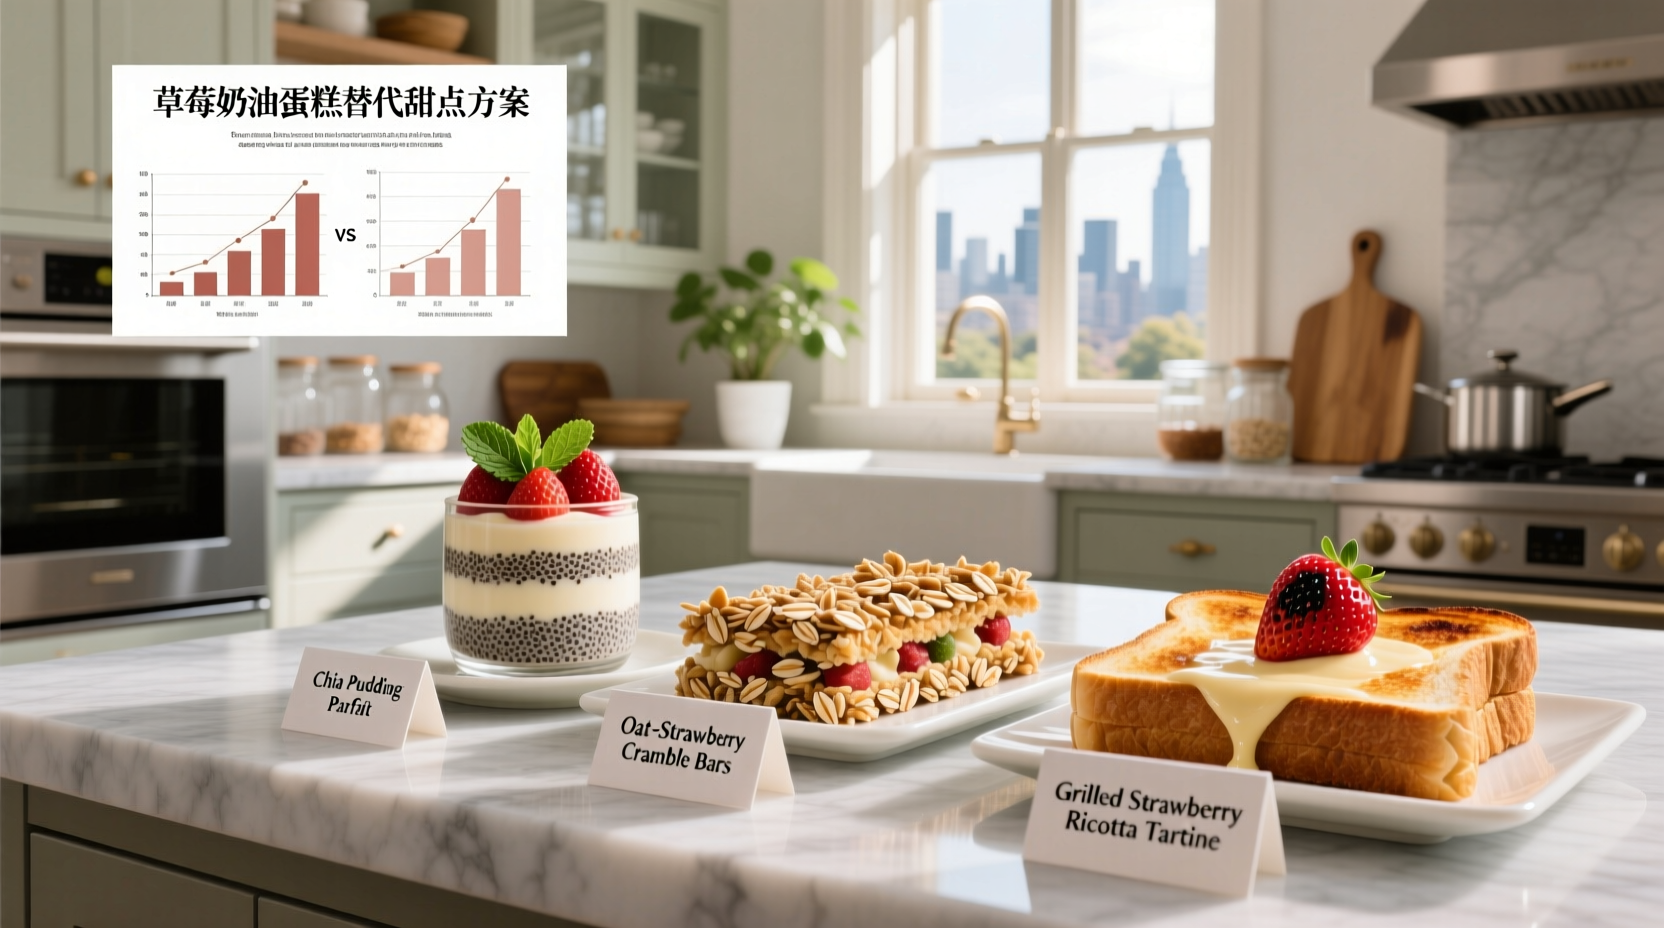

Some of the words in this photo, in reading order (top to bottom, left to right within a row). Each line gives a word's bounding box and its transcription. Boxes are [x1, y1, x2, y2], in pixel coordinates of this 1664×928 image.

[312, 670, 344, 690] Chia
[346, 674, 403, 702] Pudding
[620, 715, 746, 754] Oat-Strawberry
[621, 741, 691, 769] Cramble
[694, 751, 732, 775] Bars
[1055, 781, 1124, 808] Grilled
[1128, 790, 1243, 829] Strawberry
[1065, 809, 1138, 839] Ricotta
[1146, 820, 1221, 851] Tartine
